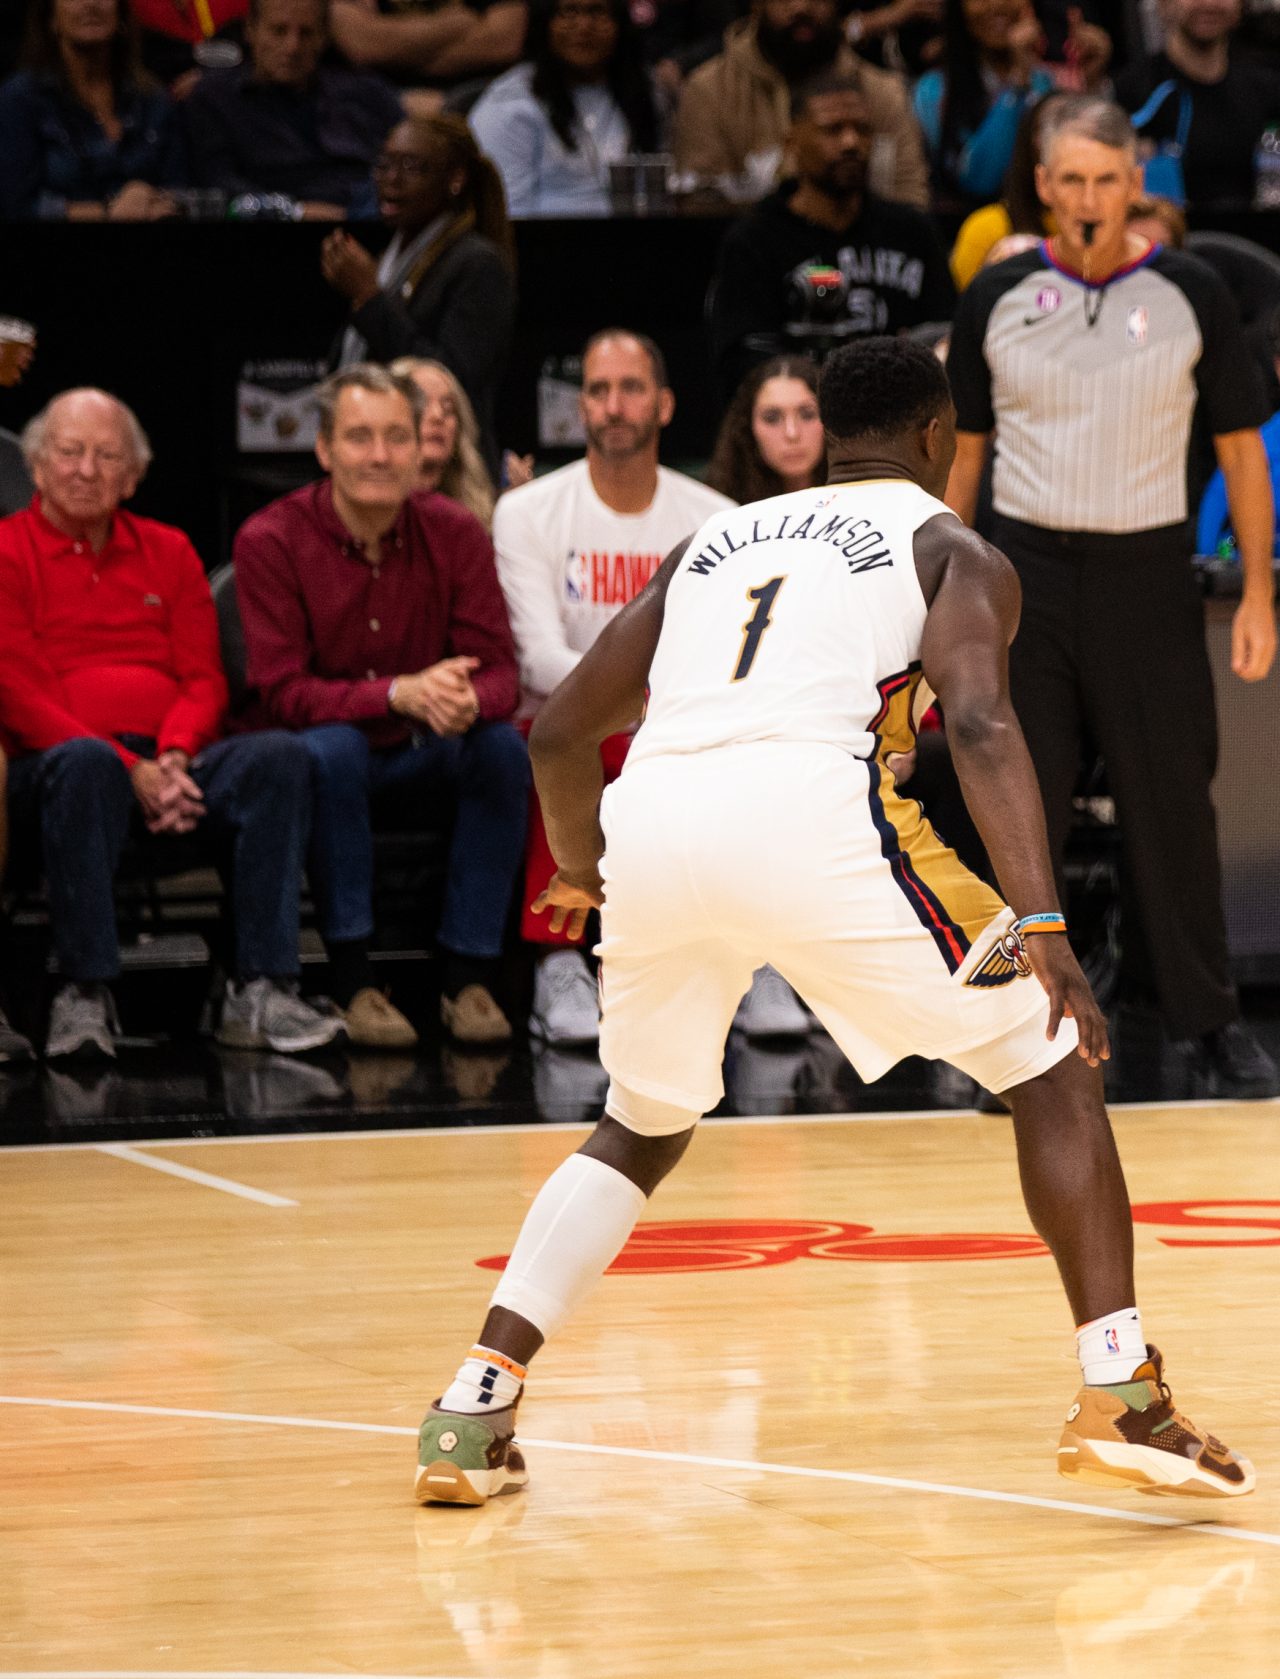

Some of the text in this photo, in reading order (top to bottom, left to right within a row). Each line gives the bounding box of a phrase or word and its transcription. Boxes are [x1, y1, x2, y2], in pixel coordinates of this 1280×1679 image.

[686, 513, 894, 576] WILLIAMSON
[591, 550, 666, 606] HAW
[729, 574, 789, 684] 1
